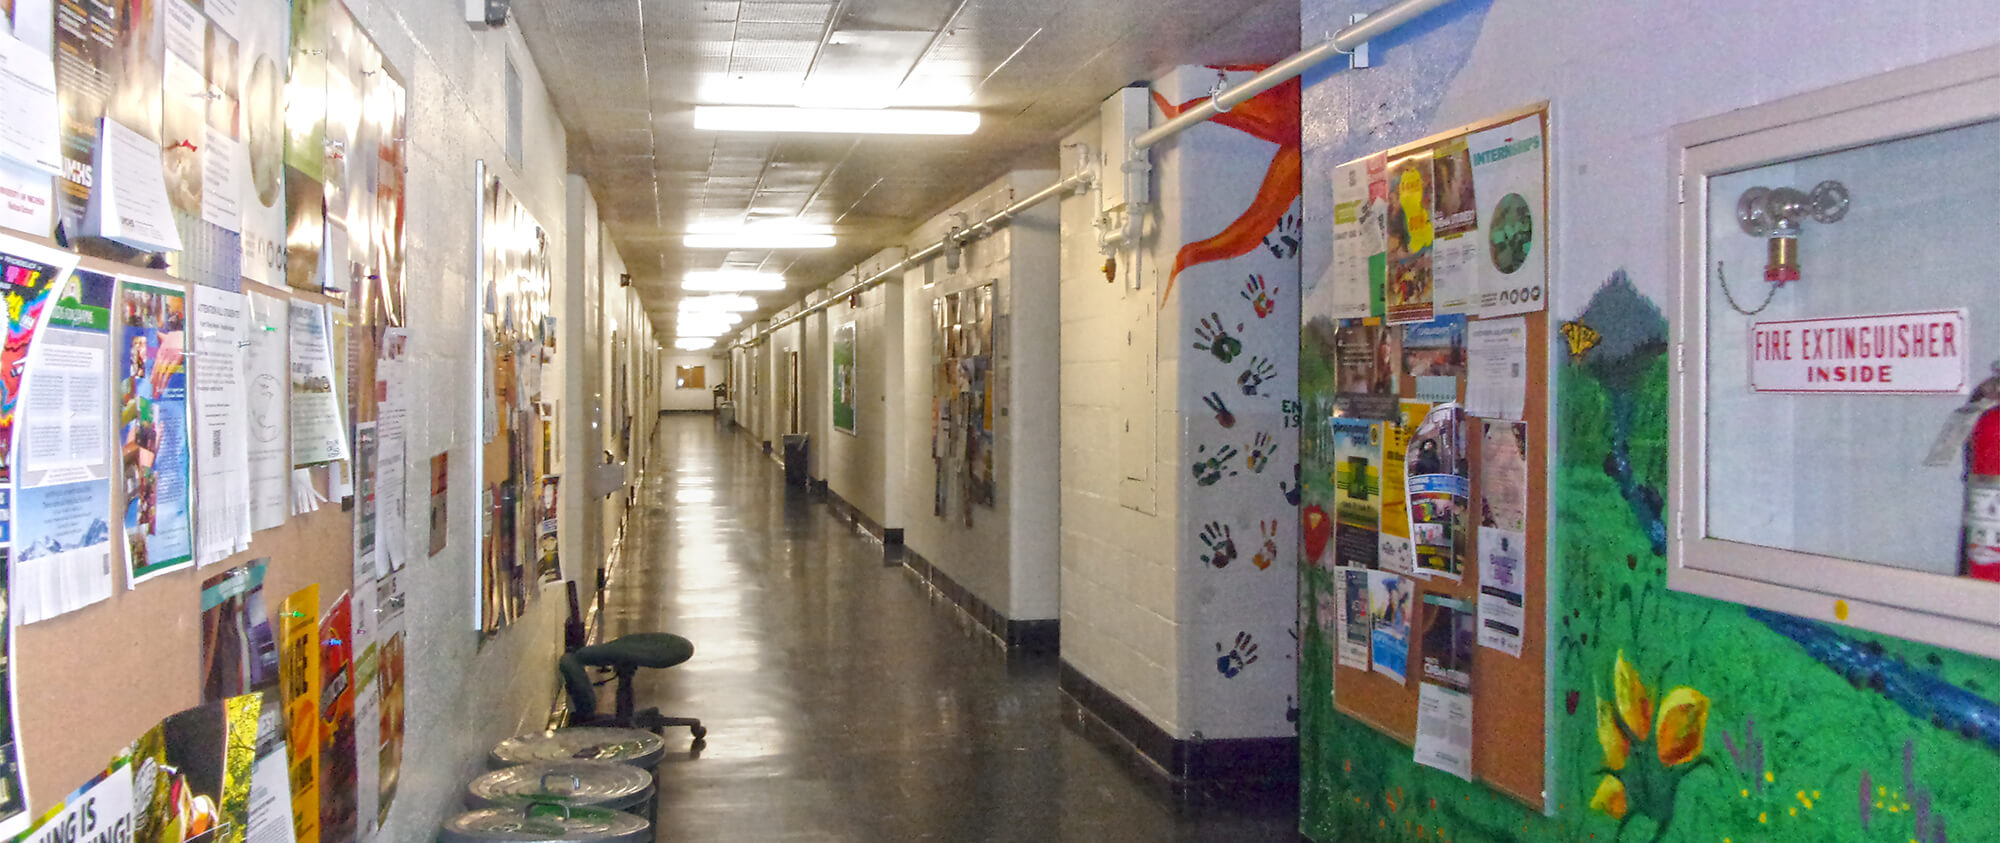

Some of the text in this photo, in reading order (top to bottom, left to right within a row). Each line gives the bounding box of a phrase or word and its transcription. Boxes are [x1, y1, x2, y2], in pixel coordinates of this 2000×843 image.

[1755, 322, 1957, 361] FIRE EXTINGUISHER
[1807, 365, 1893, 384] INSIDE
[81, 796, 97, 837] IS
